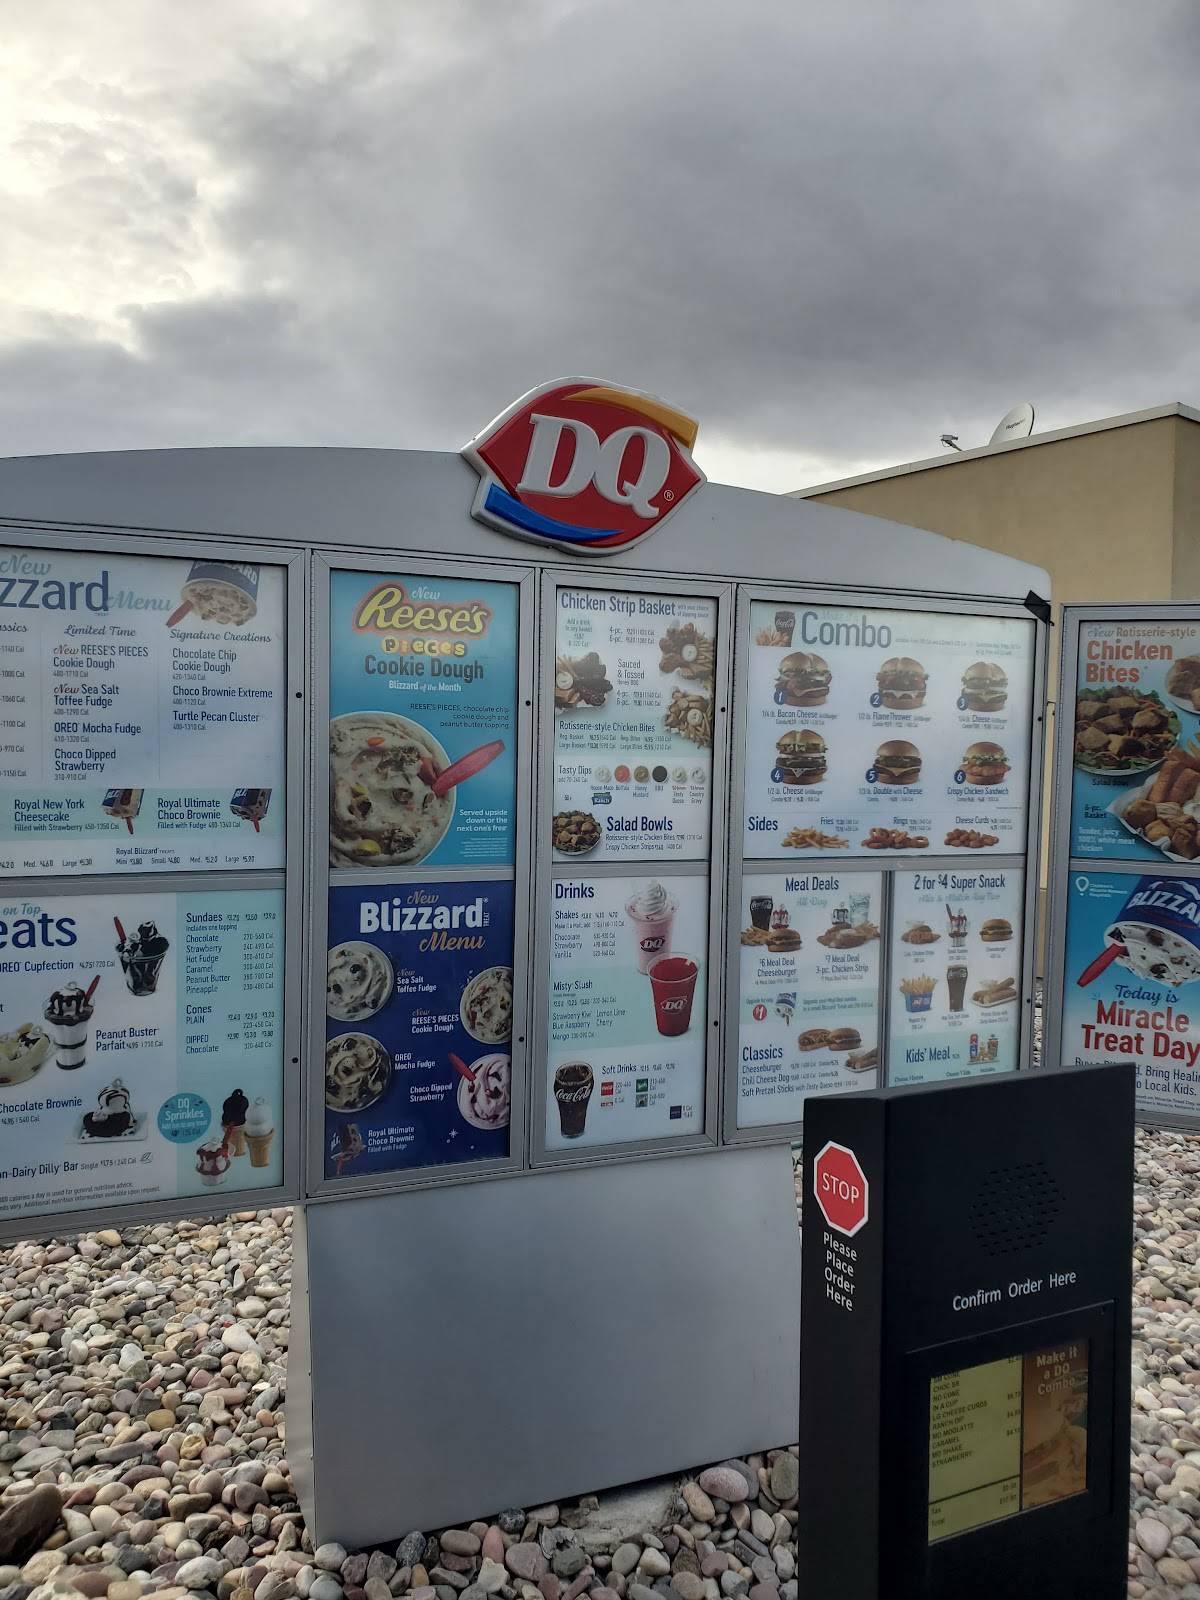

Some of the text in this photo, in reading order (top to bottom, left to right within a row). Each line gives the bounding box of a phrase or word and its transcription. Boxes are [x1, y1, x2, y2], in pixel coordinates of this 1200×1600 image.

[516, 413, 659, 519] DQ
[0, 553, 51, 576] New
[0, 570, 109, 611] zzard
[412, 586, 440, 600] New
[109, 590, 173, 612] Menu
[562, 593, 606, 611] Chicken
[609, 596, 635, 617] Strip
[639, 600, 675, 616] Basket
[359, 588, 487, 634] Reese's
[64, 624, 136, 637] Limited Time
[169, 629, 271, 643] Signature Creations
[801, 611, 891, 648] Combo
[1088, 627, 1196, 639] New Rotisserie-style
[172, 648, 236, 661] Chocolate Chip
[1087, 640, 1173, 660] Chicken
[53, 657, 115, 669] Cookie Dough
[172, 661, 231, 673] Cookie Dough
[365, 655, 483, 682] Cookie Dough
[618, 659, 640, 668] Sauced
[1086, 662, 1139, 683] Bites
[54, 684, 119, 695] New Sea Salt
[173, 685, 273, 698] Choco Brownie Extreme
[54, 696, 113, 708] Toffee Fudge
[173, 710, 259, 722] Turtle Pecan Cluster
[54, 722, 141, 735] OREO Mocha Fudge
[560, 721, 655, 732] Rotisserie-style Chicken Bites
[55, 749, 116, 760] Choco Dipped
[55, 761, 105, 772] Strawberry
[559, 765, 592, 775] Tasty Dips
[15, 799, 84, 810] Royal New York
[158, 799, 220, 809] Royal Ultimate
[15, 810, 70, 821] Cheesecake
[158, 810, 221, 819] Choco Brownie
[485, 809, 507, 817] upside
[607, 816, 672, 831] Salad Bowls
[748, 817, 778, 831] Sides
[786, 876, 839, 891] Meal Deals
[914, 874, 1005, 891] 2 for $4 Super Snack
[407, 890, 439, 904] New
[555, 883, 594, 898] Drinks
[3, 903, 42, 916] on Top
[1127, 890, 1200, 924] BLIZZA
[186, 913, 222, 923] Sundaes
[360, 898, 483, 933] Blizzard
[555, 911, 578, 919] Shakes
[186, 934, 218, 943] Chocolate
[419, 931, 485, 952] Menu
[186, 944, 222, 953] Strawberry
[0, 960, 74, 972] REO Cupfection
[397, 984, 436, 993] Toffee Fudge
[554, 980, 592, 991] Misty Slush
[1115, 985, 1179, 1006] Today is
[186, 1005, 212, 1014] Cones
[1097, 999, 1189, 1032] Miracle
[186, 1016, 205, 1024] PLAIN
[553, 1021, 590, 1030] Blue Raspberry
[96, 1028, 156, 1040] Peanut Buster
[412, 1024, 453, 1034] Cookie Dough
[96, 1040, 126, 1051] Parfait
[186, 1045, 218, 1054] Chocolate
[1082, 1024, 1200, 1067] Treat Day
[395, 1053, 411, 1061] OREO
[743, 1045, 782, 1061] Classics
[906, 1045, 950, 1063] Kids' Meal
[395, 1060, 435, 1070] Mocha Fudge
[602, 1064, 636, 1075] Soft Drinks
[743, 1064, 781, 1074] Cheeseburger
[1146, 1066, 1170, 1082] Bring
[410, 1083, 452, 1094] Choco Dipped
[1145, 1079, 1196, 1096] Local Kids.
[46, 1098, 82, 1110] Brownie
[410, 1093, 444, 1102] Strawberry
[165, 1108, 204, 1122] Sprinkles
[369, 1126, 414, 1138] Royal Ultimate
[389, 1135, 414, 1143] Brownie
[821, 1172, 859, 1204] STOP
[823, 1231, 857, 1261] Please
[826, 1251, 854, 1276] Place
[824, 1267, 855, 1295] Order
[826, 1283, 853, 1311] Here
[953, 1271, 1076, 1312] Confirm Order Here
[1037, 1351, 1065, 1367] Make
[1038, 1378, 1075, 1395] Combo
